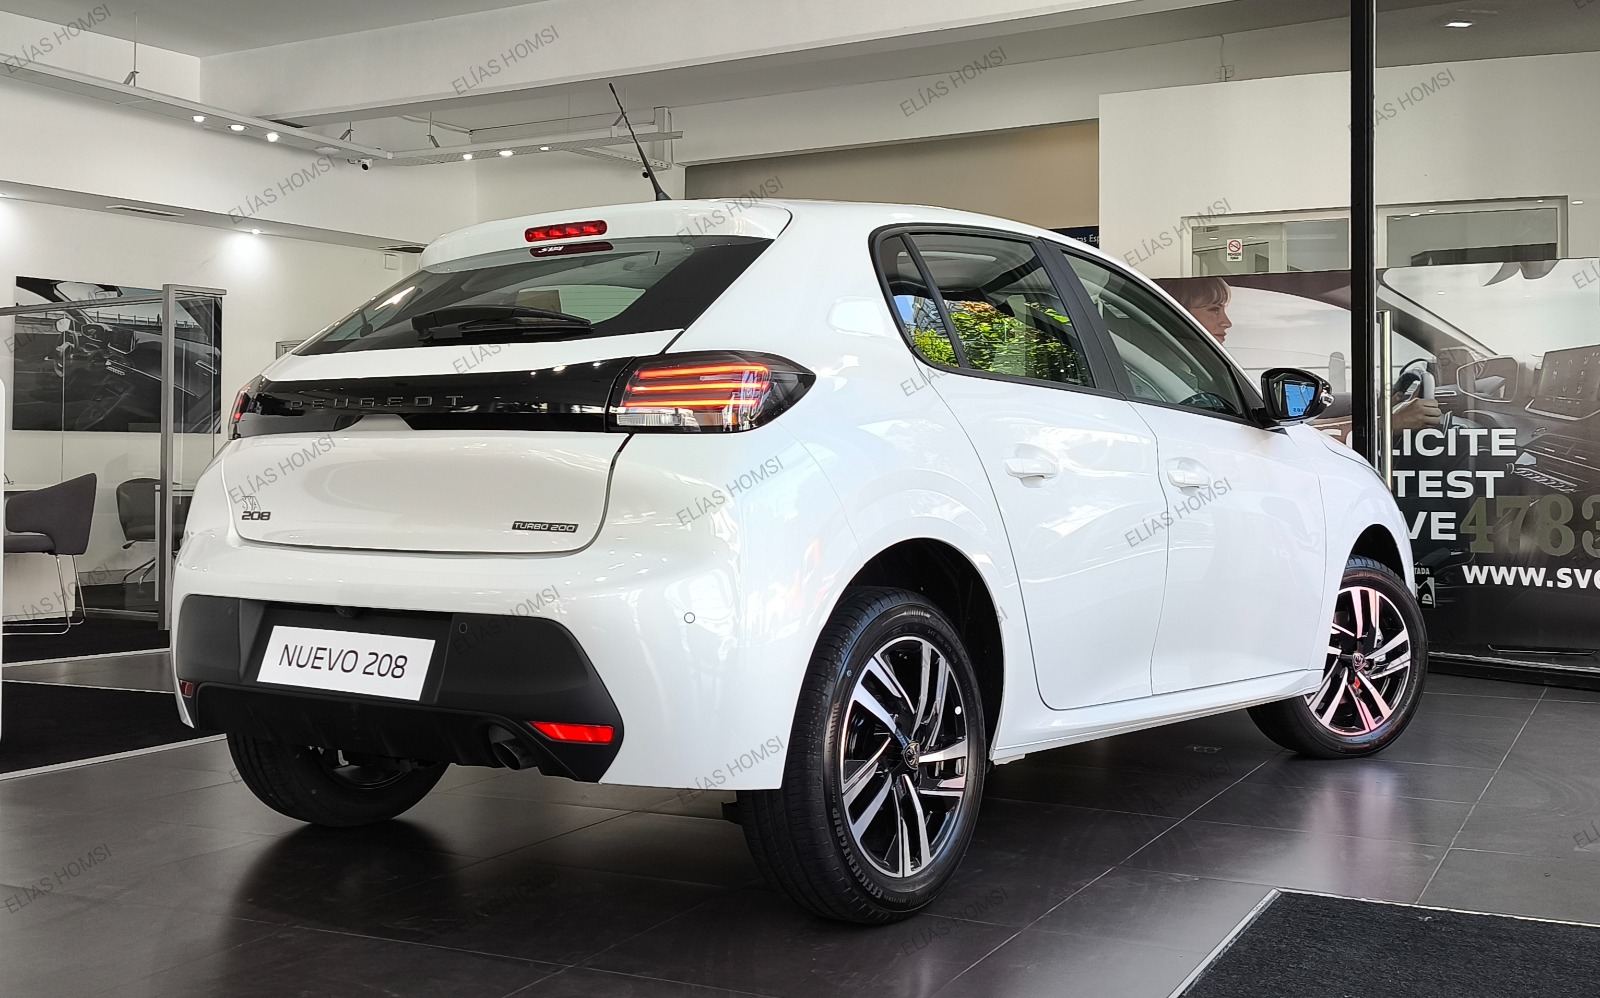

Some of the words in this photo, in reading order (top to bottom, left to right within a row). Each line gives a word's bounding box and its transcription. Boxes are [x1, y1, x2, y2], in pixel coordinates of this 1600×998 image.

[290, 396, 463, 410] PEUGEOT
[1392, 470, 1505, 499] TEST
[242, 511, 271, 520] 208
[514, 522, 549, 530] TURBO
[550, 524, 576, 532] 200
[279, 644, 359, 673] NUEVO
[362, 652, 408, 679] 208
